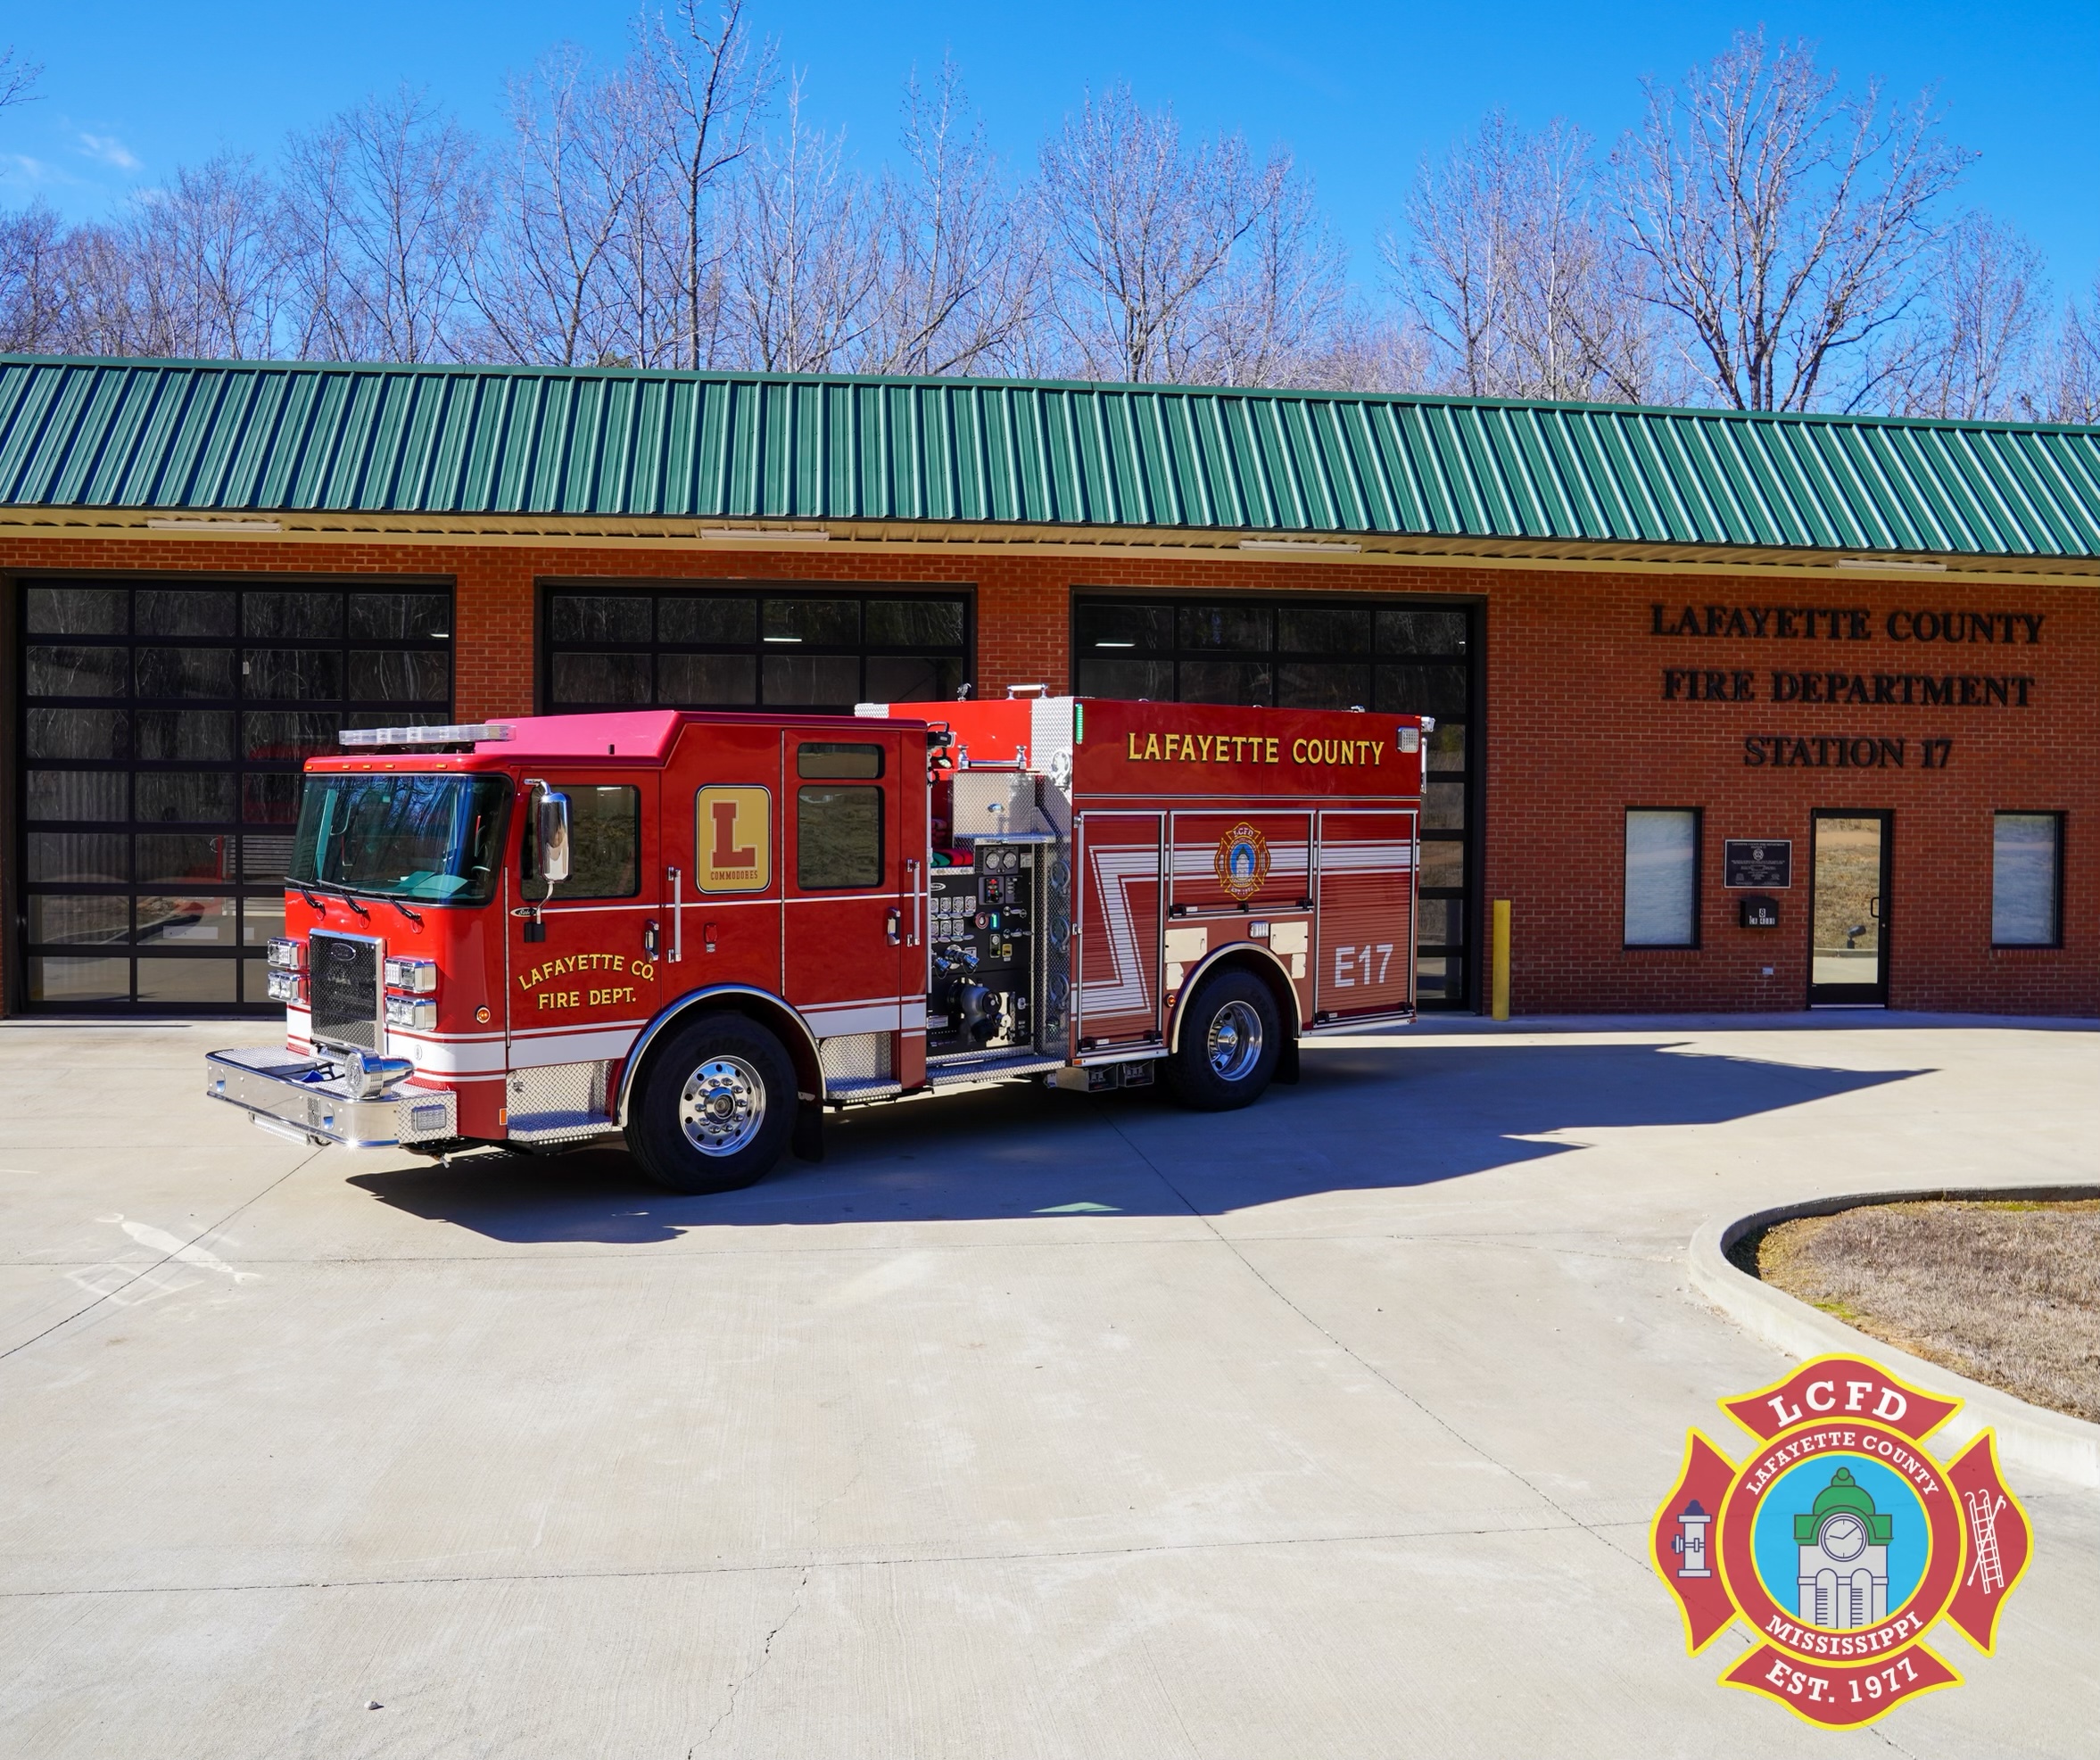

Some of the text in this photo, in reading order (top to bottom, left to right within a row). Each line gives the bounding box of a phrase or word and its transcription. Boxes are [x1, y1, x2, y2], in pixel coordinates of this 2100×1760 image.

[1650, 604, 2046, 644] LAFAYETTE COUNTY
[1662, 669, 2036, 707] FIRE DEPARTMENT
[1128, 732, 1385, 766] LAFAYETTE COUNTY
[1744, 735, 1954, 768] STATION 17
[710, 799, 757, 871] L
[1233, 827, 1253, 838] LCFD
[710, 871, 758, 880] COMMODORES
[517, 954, 654, 990] LAFAYETTE CO.
[1335, 944, 1393, 987] E17
[538, 987, 637, 1009] FIRE DEPT.
